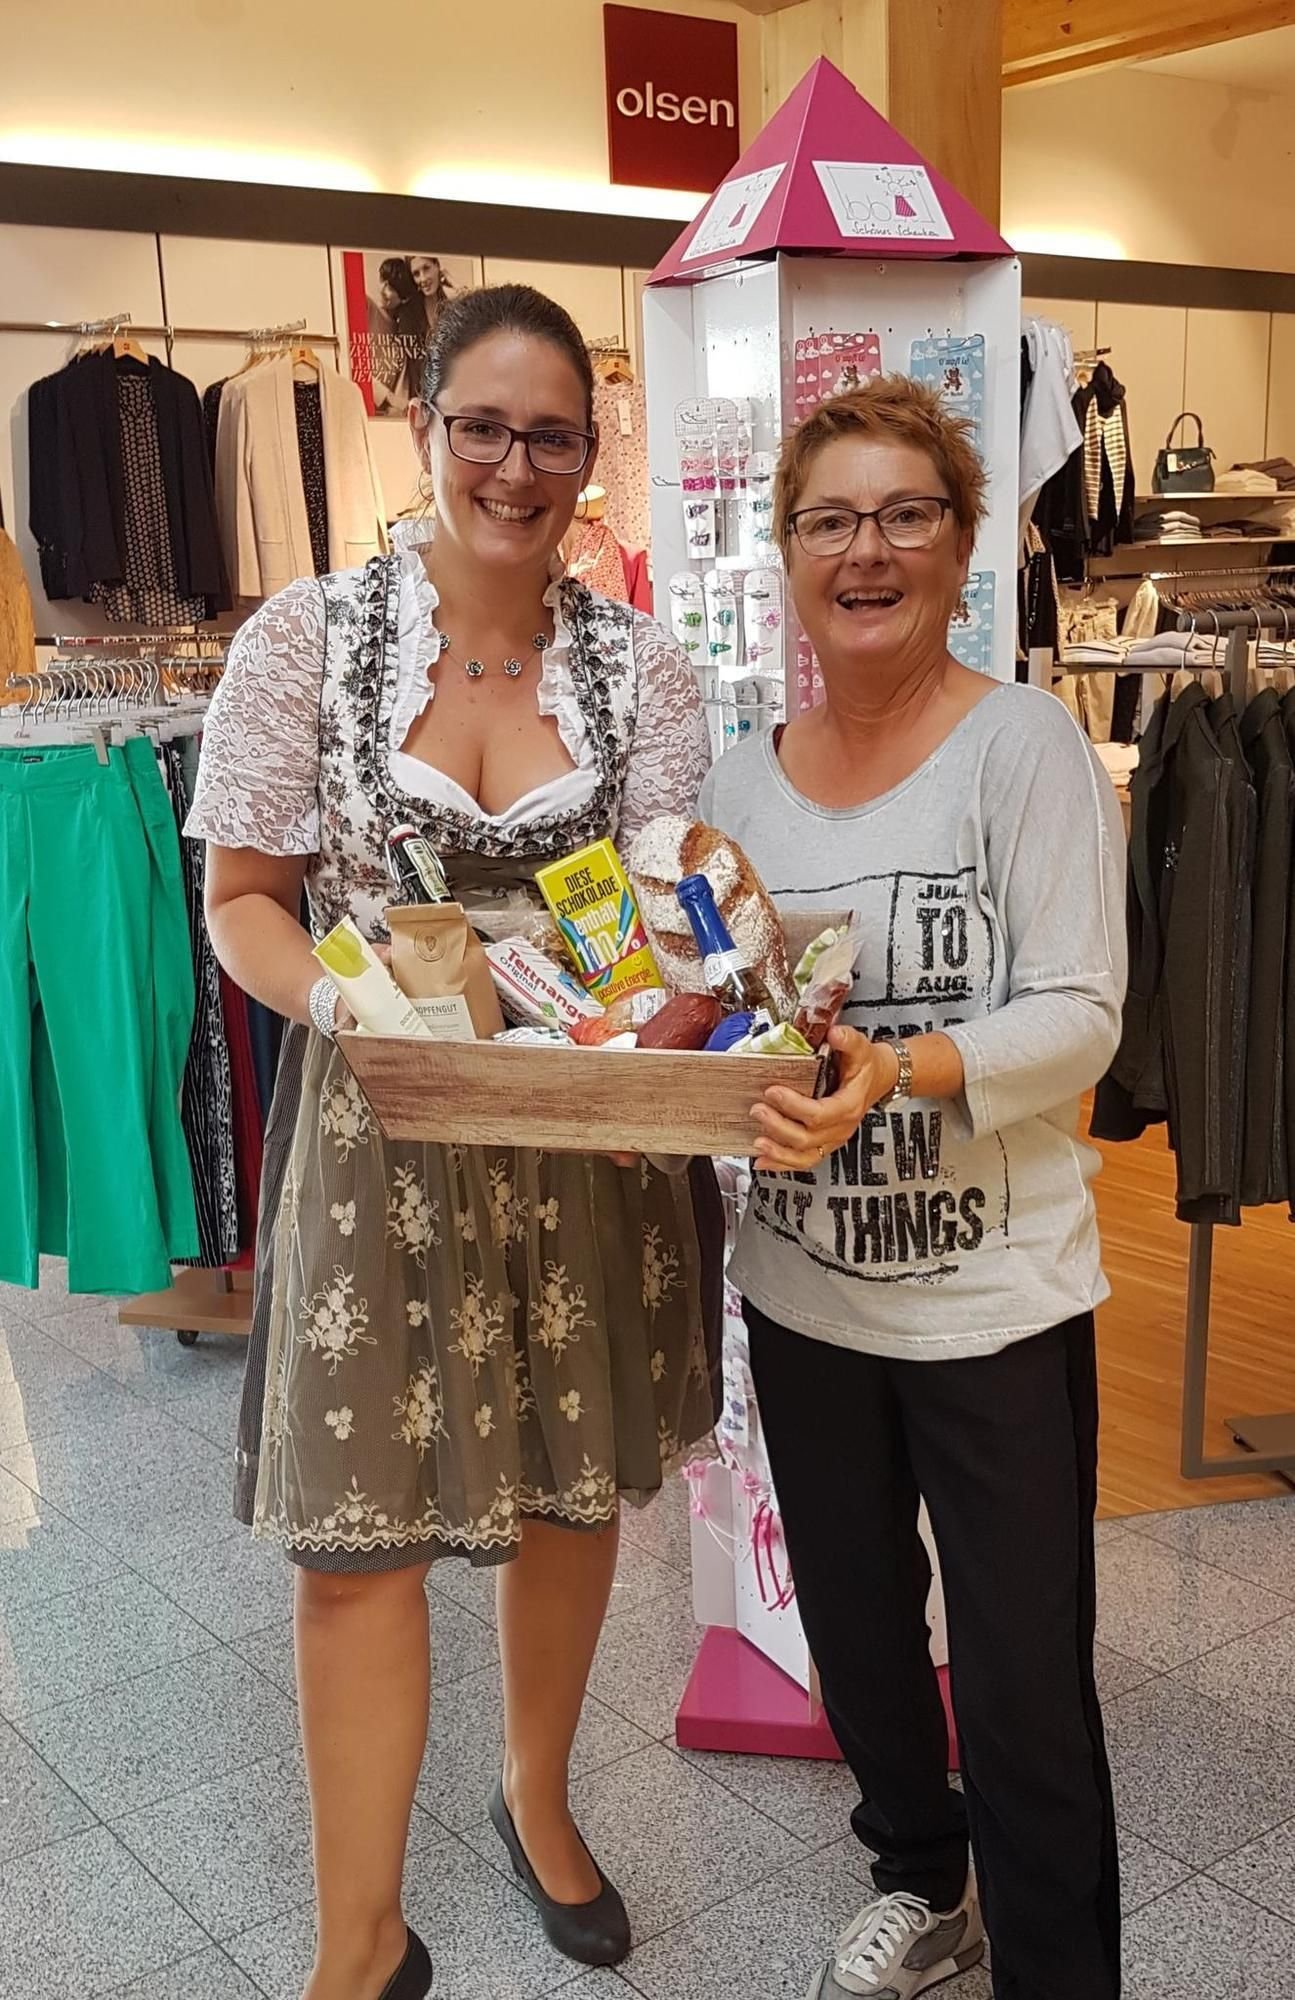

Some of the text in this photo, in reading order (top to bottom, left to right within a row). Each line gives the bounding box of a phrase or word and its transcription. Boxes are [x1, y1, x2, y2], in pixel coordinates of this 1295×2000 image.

[616, 81, 735, 128] olsen
[350, 345, 428, 360] ZEIT MEINES
[352, 332, 418, 347] DIE BESTE
[555, 876, 620, 919] SCHOKOLADE
[564, 867, 595, 894] DIESE
[917, 884, 967, 901] JUL.
[576, 925, 642, 973] 100%
[916, 905, 969, 971] TO
[500, 956, 538, 992] Original
[507, 947, 589, 1022] Tettnange
[598, 979, 627, 1000] positive
[916, 975, 974, 994] AUG.
[830, 1110, 942, 1187] NEW
[826, 1186, 986, 1265] THINGS
